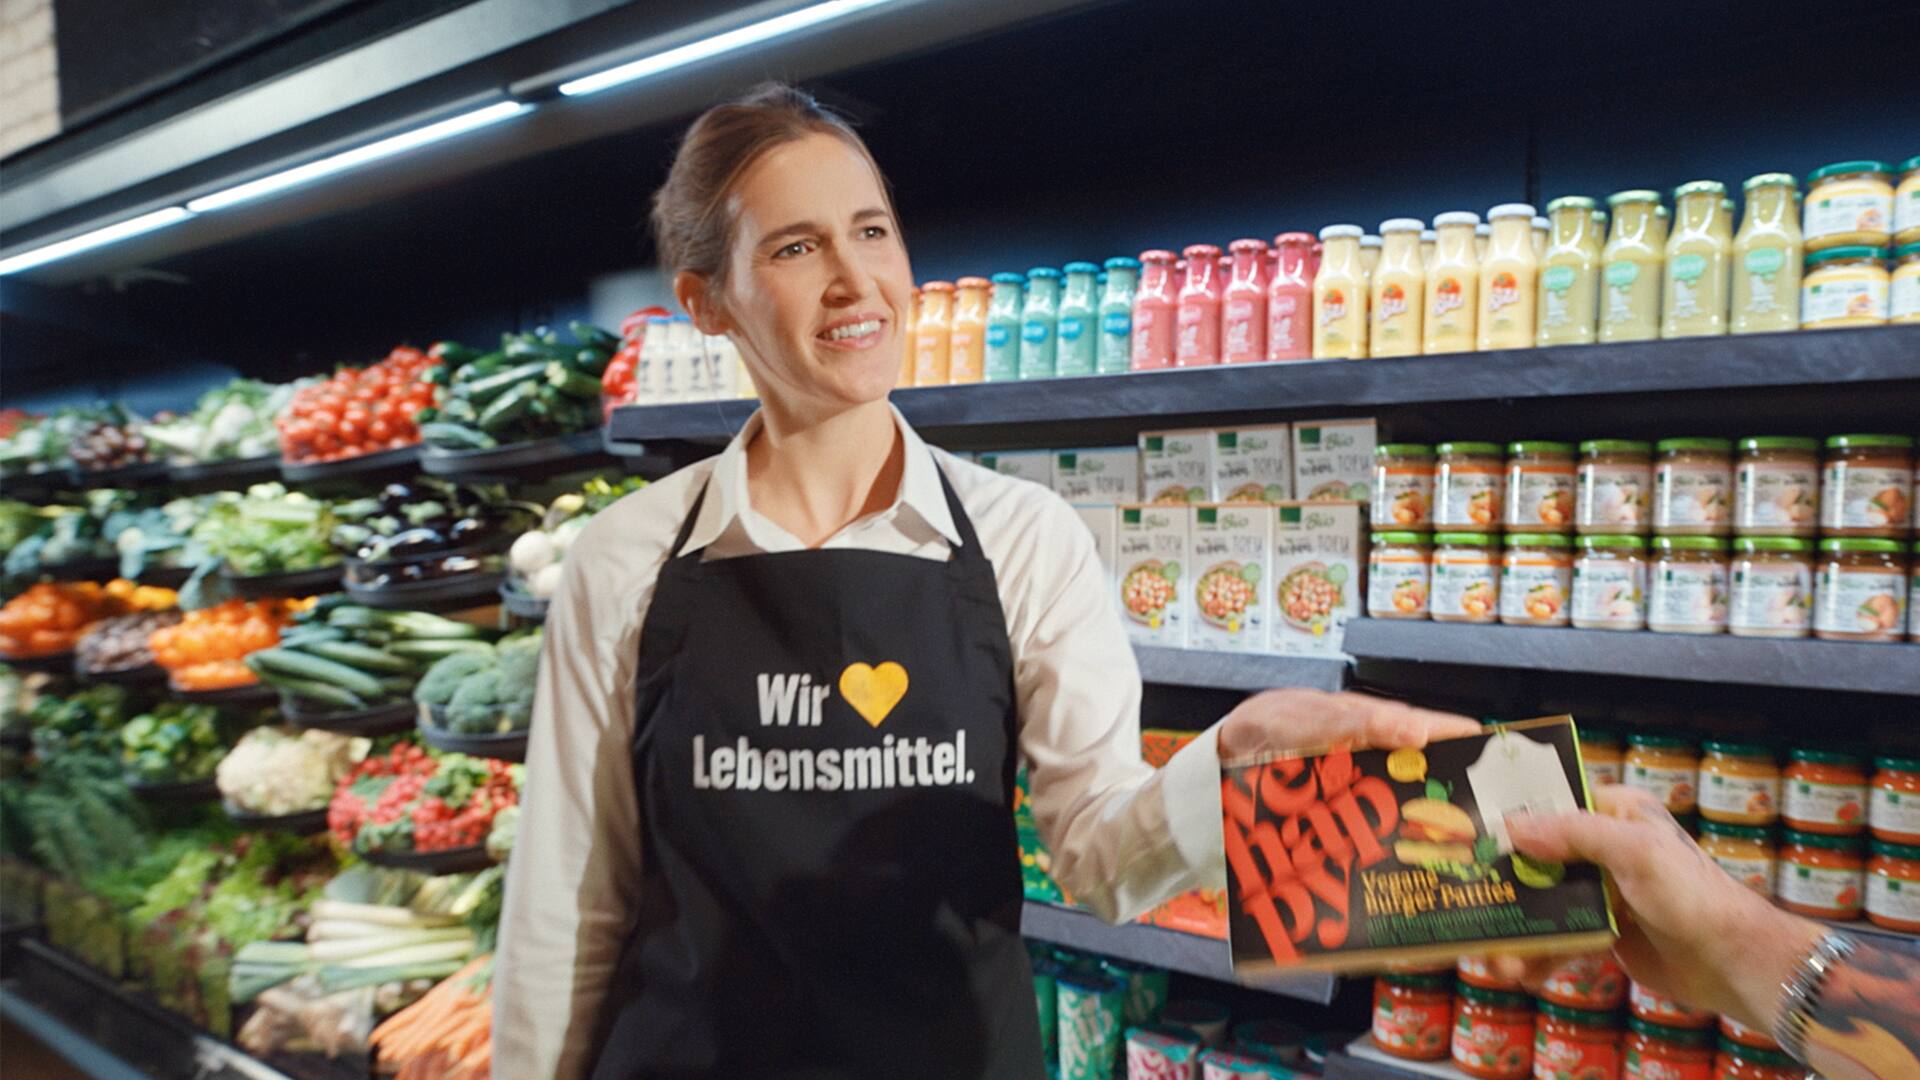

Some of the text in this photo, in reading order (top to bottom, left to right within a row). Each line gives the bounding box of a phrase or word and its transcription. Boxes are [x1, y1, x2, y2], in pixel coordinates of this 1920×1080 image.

[757, 673, 830, 727] Wir
[693, 729, 975, 792] Lebensmittel.
[1361, 869, 1438, 897] Vegane
[1441, 879, 1516, 909] Patties
